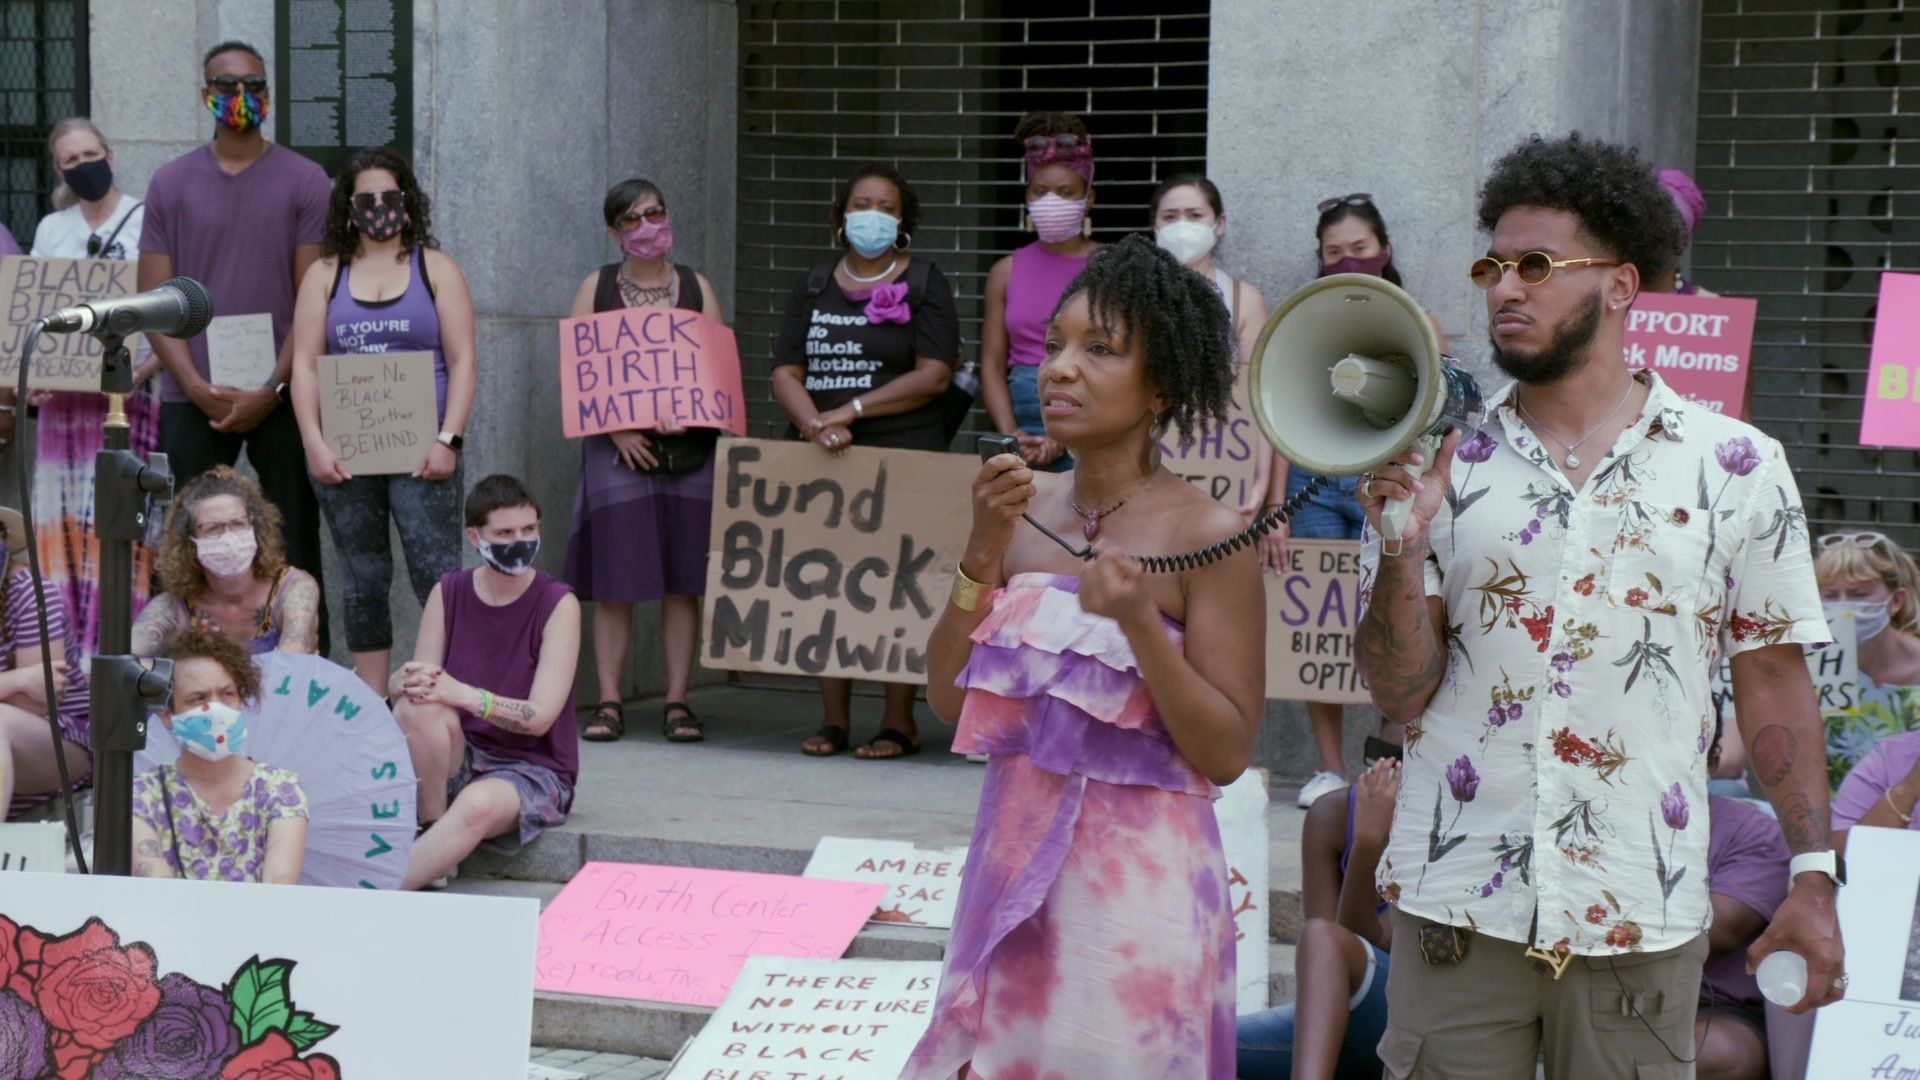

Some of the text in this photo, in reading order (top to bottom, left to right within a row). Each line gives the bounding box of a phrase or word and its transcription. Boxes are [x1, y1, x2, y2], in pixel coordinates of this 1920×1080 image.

[14, 259, 129, 294] BLACK
[336, 319, 410, 337] IF YOU'RE
[811, 309, 868, 326] Leave
[339, 333, 366, 347] NOT
[574, 313, 701, 356] BLACK
[807, 325, 829, 339] No
[805, 340, 863, 355] Black
[1654, 344, 1740, 373] Moms
[384, 360, 408, 383] No
[576, 348, 698, 392] BIRTH
[807, 357, 884, 372] Mother
[805, 374, 872, 391] Behind
[334, 387, 396, 410] BLACK
[578, 386, 734, 431] MATTERS!
[334, 430, 418, 461] BEHIND
[726, 446, 887, 533] Fund
[721, 520, 936, 619] Black
[1280, 575, 1361, 629] SA
[595, 871, 809, 919] Birth Center
[764, 973, 935, 991] THERE IS
[748, 996, 930, 1014] NO FUTURE
[731, 1021, 889, 1037] WITHOUT
[722, 1042, 876, 1062] BLACK
